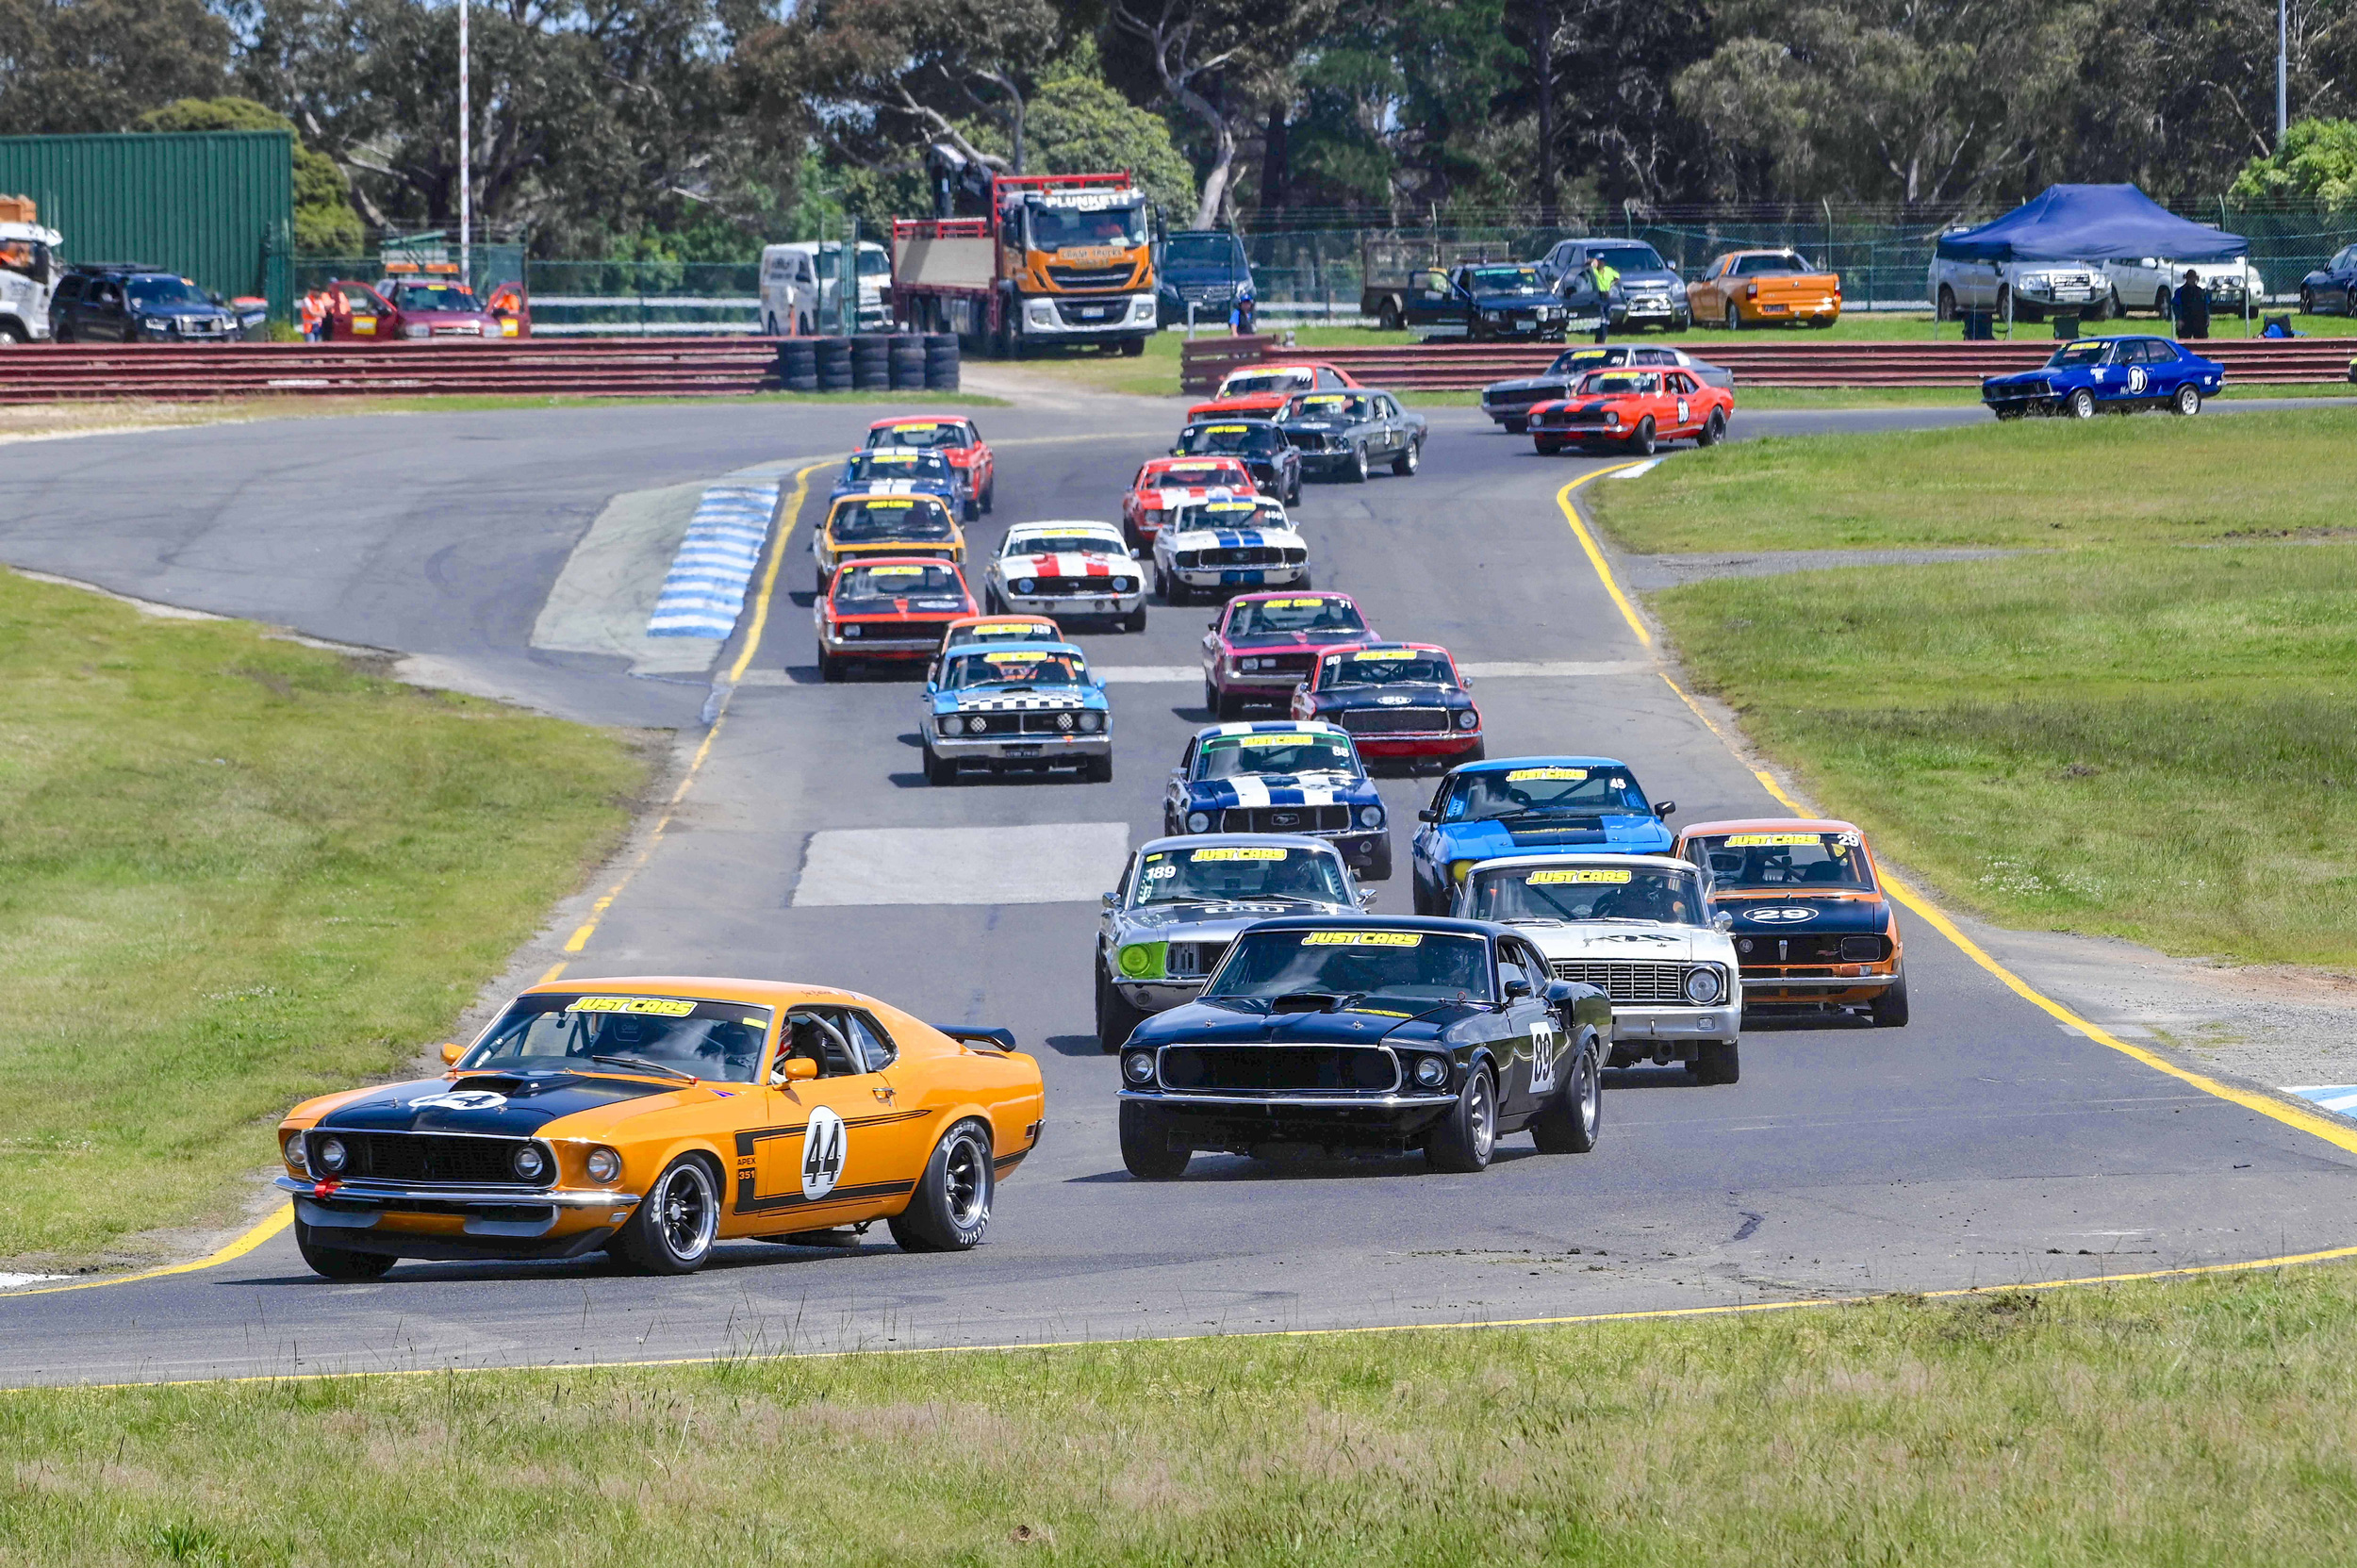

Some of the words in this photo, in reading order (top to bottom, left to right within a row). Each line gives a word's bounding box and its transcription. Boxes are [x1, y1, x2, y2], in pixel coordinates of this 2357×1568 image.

[1332, 746, 1350, 757] 88
[1609, 778, 1627, 789] 45
[1725, 834, 1772, 847] JUST
[1771, 834, 1820, 846] CARS
[1837, 834, 1859, 847] 29
[1193, 849, 1237, 861] JUST
[1237, 849, 1286, 860] CARS
[1146, 866, 1177, 880] 189
[1527, 870, 1578, 883] JUST
[1576, 869, 1630, 883] CARS
[1753, 909, 1809, 920] 29
[1303, 932, 1360, 944] JUST
[1359, 933, 1422, 947] CARS
[568, 998, 633, 1012] JUST
[625, 999, 696, 1015] CARS
[1534, 1032, 1551, 1081] 89
[802, 1119, 841, 1187] 44
[737, 1157, 756, 1165] APEX
[738, 1170, 755, 1180] 351
